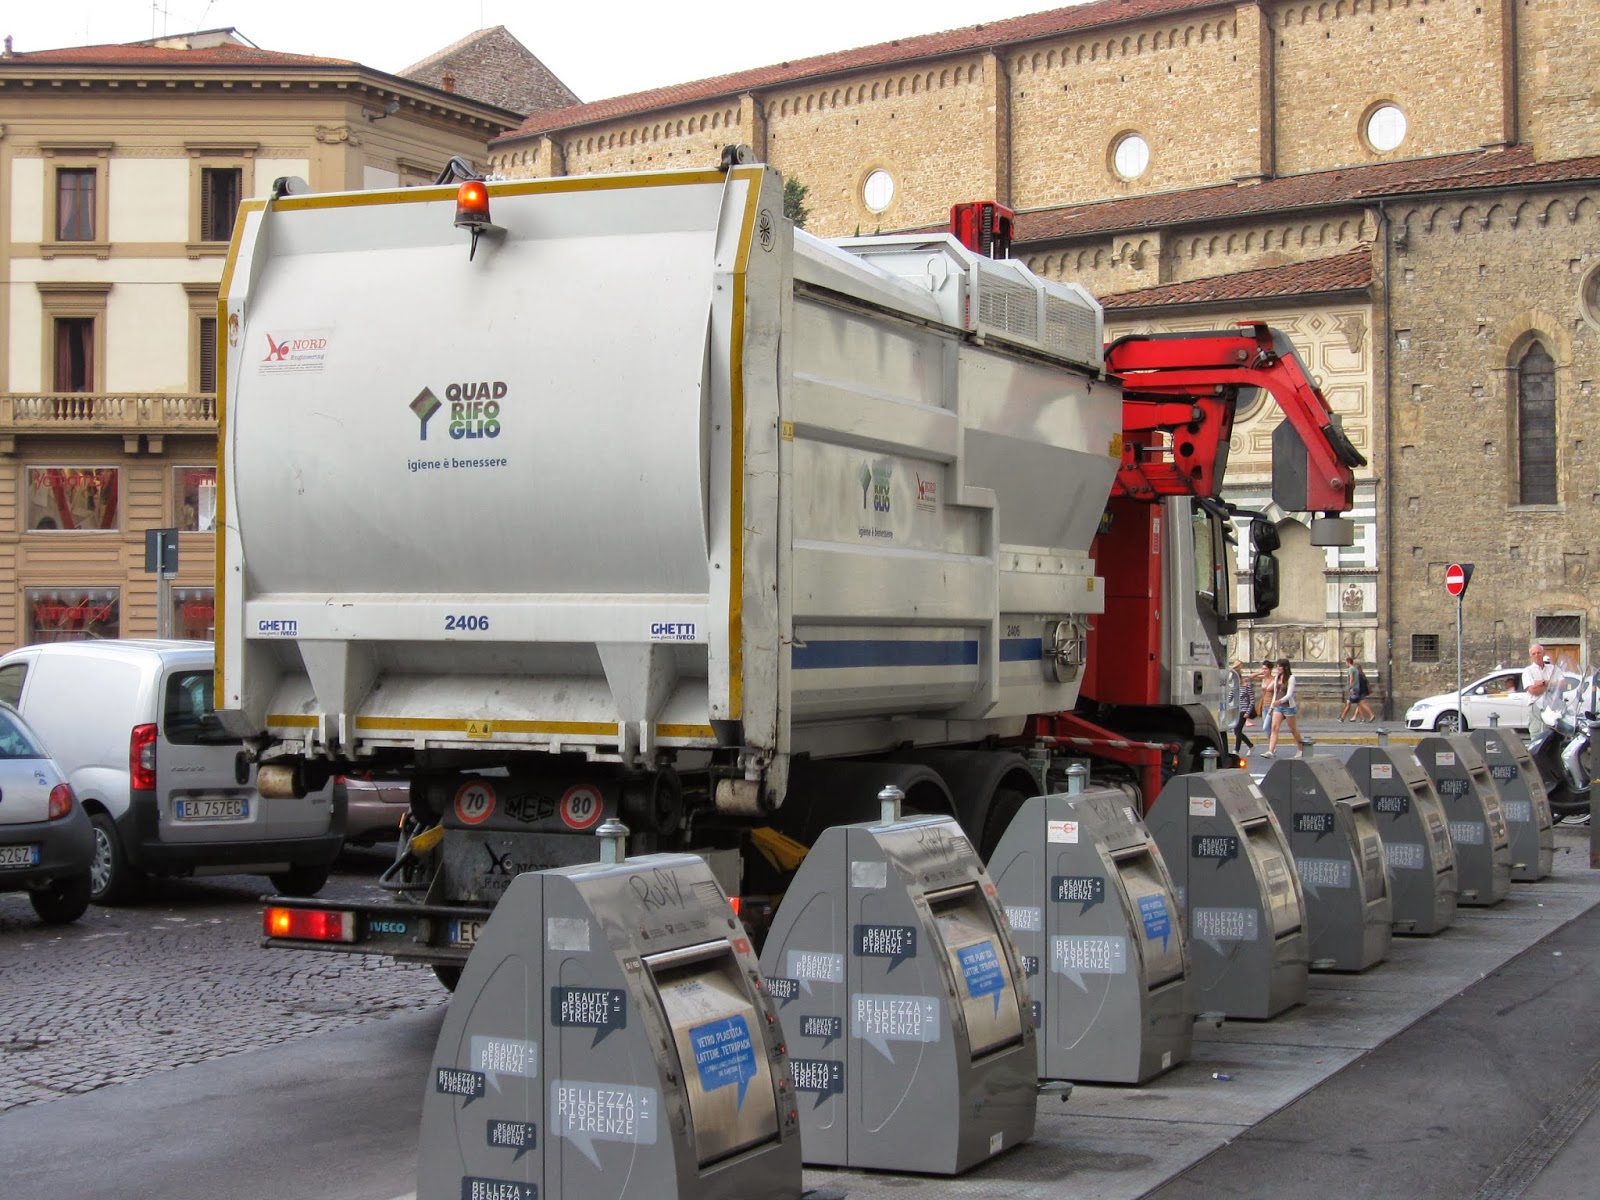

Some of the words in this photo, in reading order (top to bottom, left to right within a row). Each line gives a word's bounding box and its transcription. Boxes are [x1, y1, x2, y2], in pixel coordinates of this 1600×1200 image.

[292, 339, 327, 350] NORD
[445, 381, 508, 402] QUAD
[451, 400, 500, 420] RIFO
[449, 419, 501, 440] GLIO
[407, 459, 440, 472] igiene
[443, 458, 450, 468] è
[452, 457, 507, 468] benessere
[259, 620, 297, 631] GHETTI
[445, 615, 489, 630] 2406
[651, 623, 695, 634] GHETTI
[466, 793, 484, 811] 70
[571, 797, 592, 814] 80
[185, 802, 199, 816] EA
[205, 801, 241, 816] 757EG
[1059, 886, 1092, 894] RESPECT
[1059, 892, 1092, 900] FIRENZE
[1197, 912, 1243, 921] BELLEZZA
[369, 922, 406, 934] IVECO
[1197, 920, 1244, 928] RISPETTO
[1203, 927, 1243, 936] FIRENZE
[862, 936, 902, 946] RESPECT
[1056, 940, 1110, 951] BELLEZZA
[862, 944, 902, 954] FIRENZE
[1056, 949, 1110, 959] RISPETTO
[801, 954, 833, 964] BEAUTY
[1063, 958, 1110, 968] FIRENZE
[796, 961, 832, 972] RESPECT
[796, 969, 831, 979] FIRENZE
[561, 1001, 608, 1014] RESPECT
[857, 1000, 921, 1014] BELLEZZA
[561, 1011, 608, 1023] FIRENZE
[857, 1011, 921, 1024] RISPETTO
[866, 1022, 920, 1035] FIRENZE
[488, 1042, 525, 1055] BEAUTY
[481, 1050, 524, 1065] RESPECT
[481, 1060, 523, 1073] FIRENZE
[439, 1070, 475, 1081] BELLEZZA
[792, 1070, 829, 1081] ESPETO
[439, 1076, 475, 1088] RISPETTO
[794, 1078, 828, 1088] IRENZE
[443, 1084, 474, 1095] FIRENZE
[558, 1087, 634, 1107] BELLEZZA
[558, 1102, 634, 1120] RISPETTO
[568, 1116, 633, 1135] FIRENZE
[493, 1129, 524, 1140] RESPECT
[493, 1136, 524, 1145] FIRENZE
[472, 1181, 520, 1197] BELLEZA
